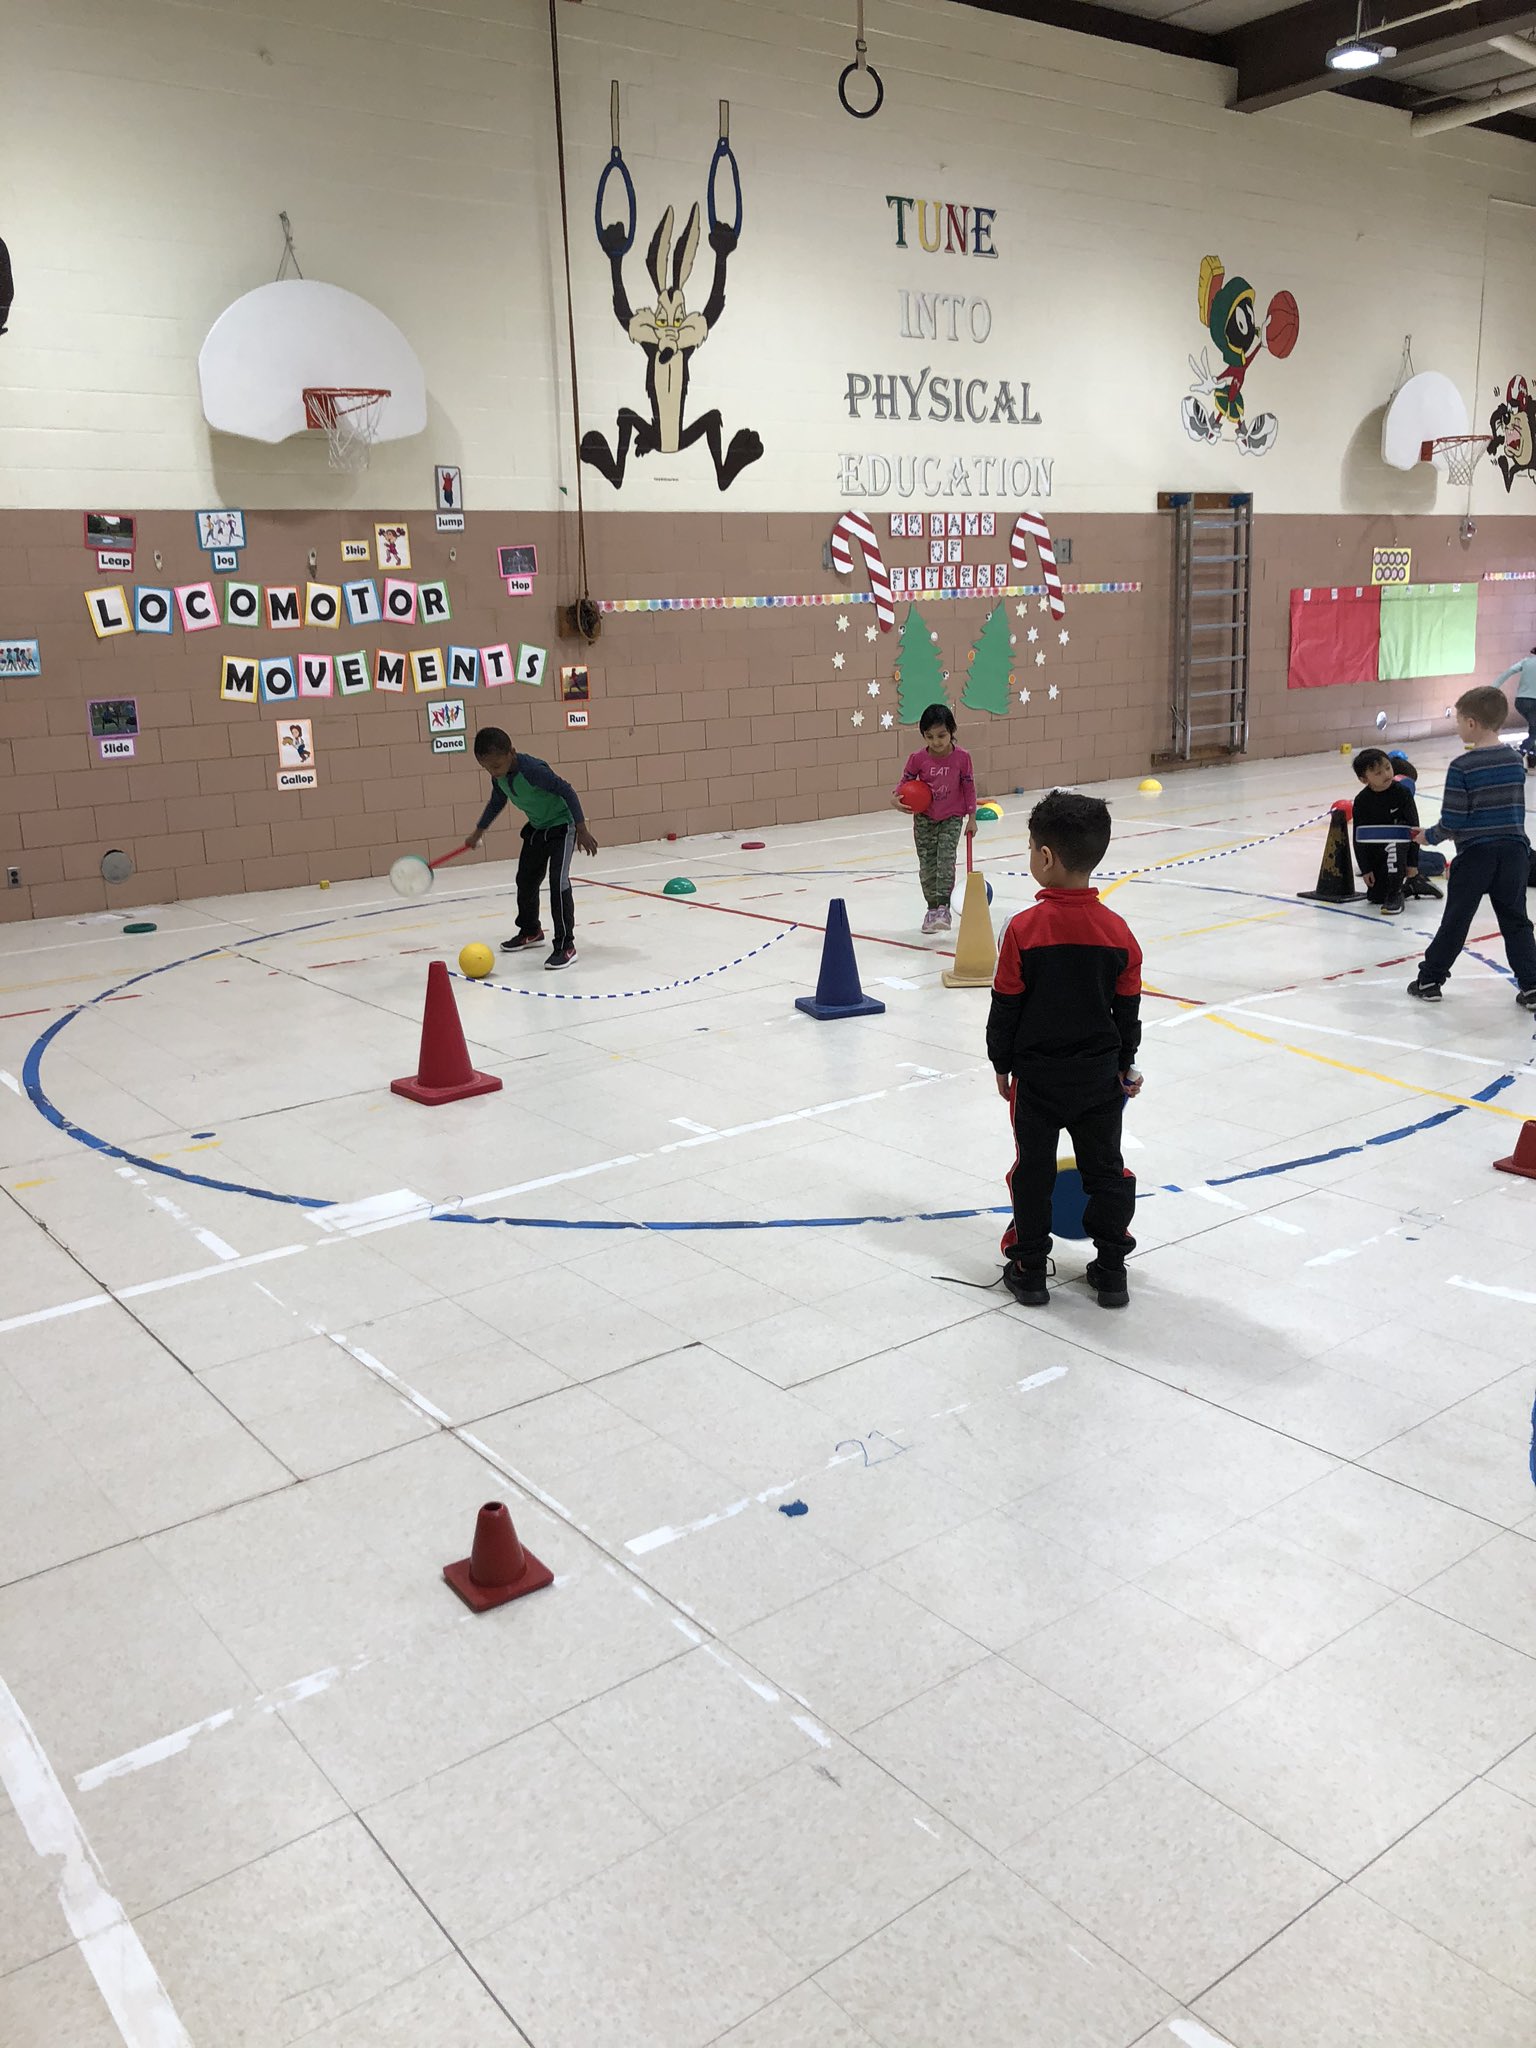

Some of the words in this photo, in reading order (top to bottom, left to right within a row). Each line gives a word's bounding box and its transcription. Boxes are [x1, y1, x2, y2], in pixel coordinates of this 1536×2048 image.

[886, 195, 998, 258] TUNE
[898, 289, 991, 343] INTO
[844, 366, 1042, 424] PHYSICAL
[837, 453, 1055, 497] EDUCATION
[438, 517, 463, 527] Jump
[932, 514, 993, 535] DAYS
[345, 545, 367, 556] Skip
[931, 540, 960, 562] OF
[101, 554, 130, 567] Leap
[217, 555, 234, 566] Jog
[892, 566, 1006, 589] FITNESS
[511, 580, 530, 591] Hop
[96, 586, 445, 628] LOCOMOTOR
[225, 651, 539, 695] MOVEMENTS
[569, 714, 586, 723] Run
[103, 743, 130, 754] Slide
[435, 739, 463, 749] Dance
[930, 767, 949, 777] EAT
[280, 774, 314, 786] Gallop
